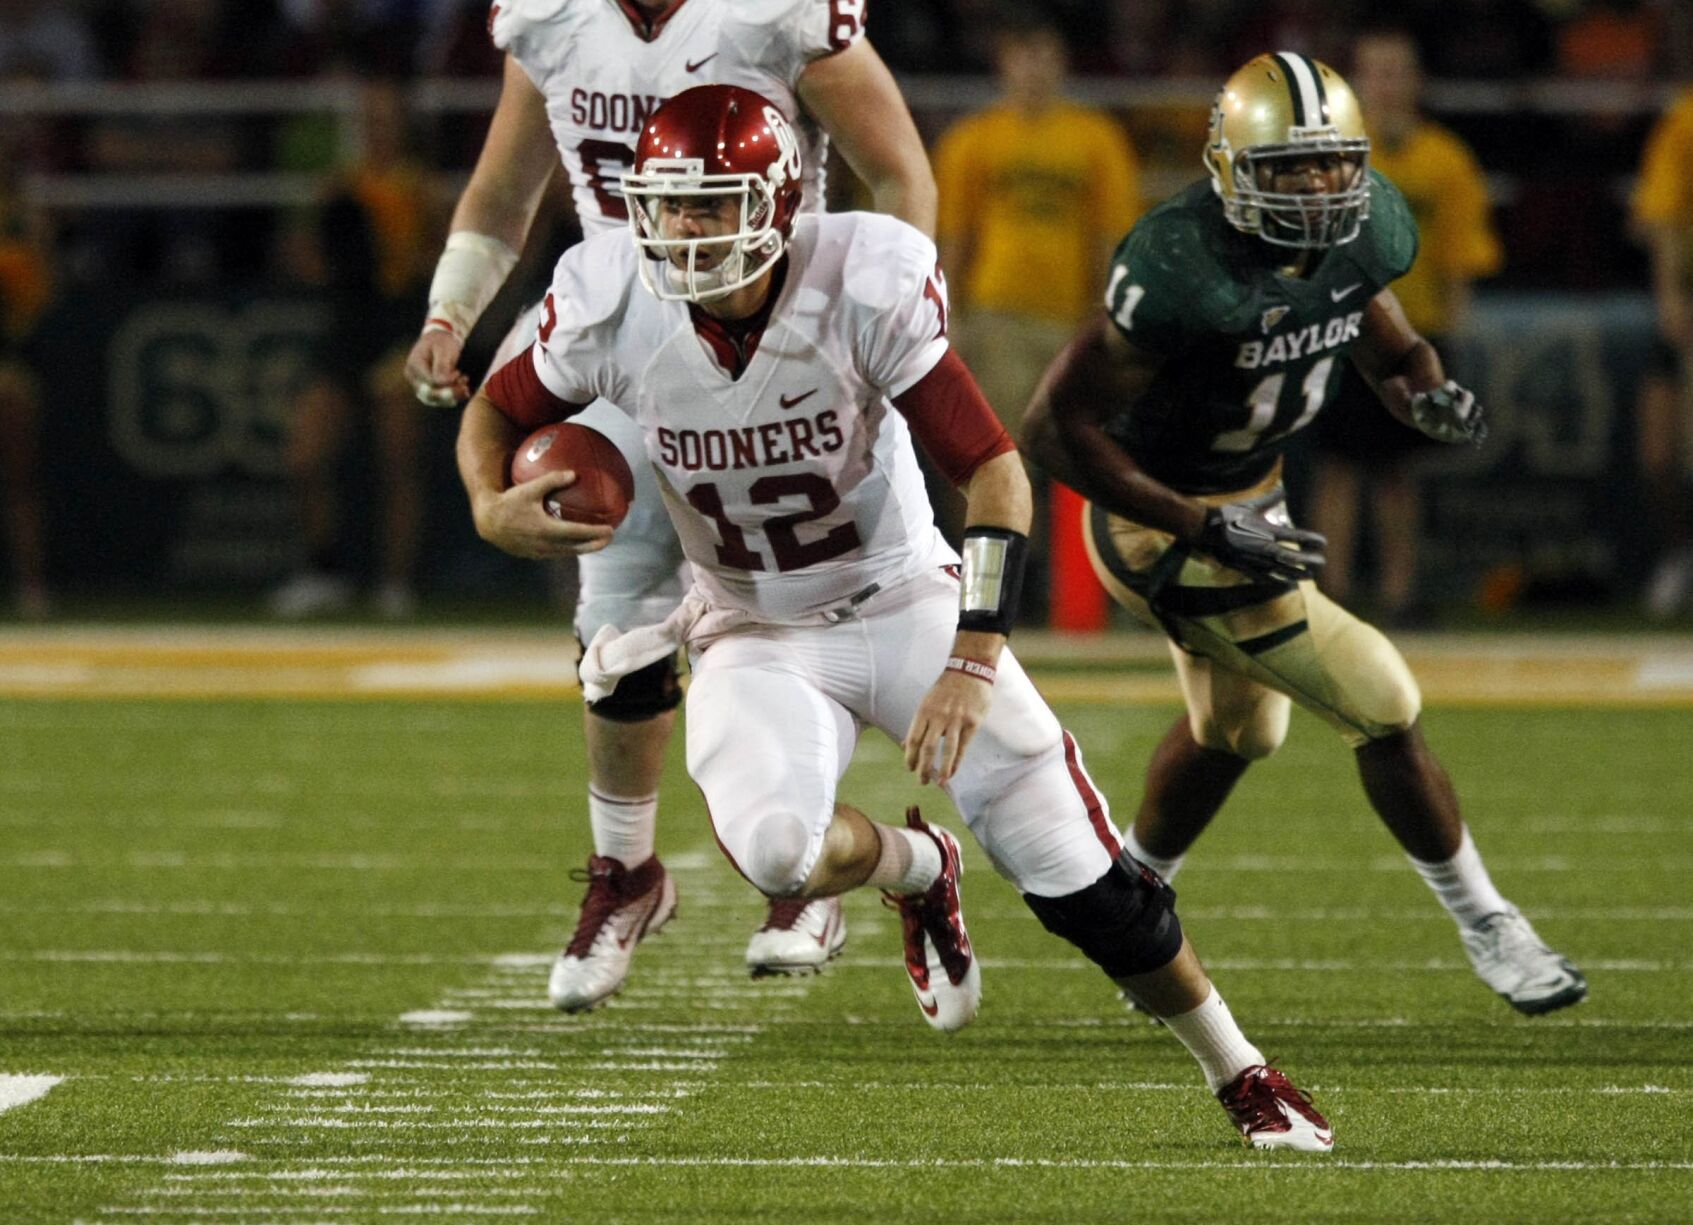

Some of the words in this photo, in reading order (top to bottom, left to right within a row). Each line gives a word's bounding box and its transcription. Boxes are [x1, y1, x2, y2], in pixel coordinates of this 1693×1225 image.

[571, 87, 672, 133] SOON
[1105, 264, 1146, 331] 11
[1234, 311, 1364, 370] BAYLOR
[1211, 356, 1335, 452] 11
[657, 410, 844, 471] SOONERS
[686, 472, 862, 573] 12
